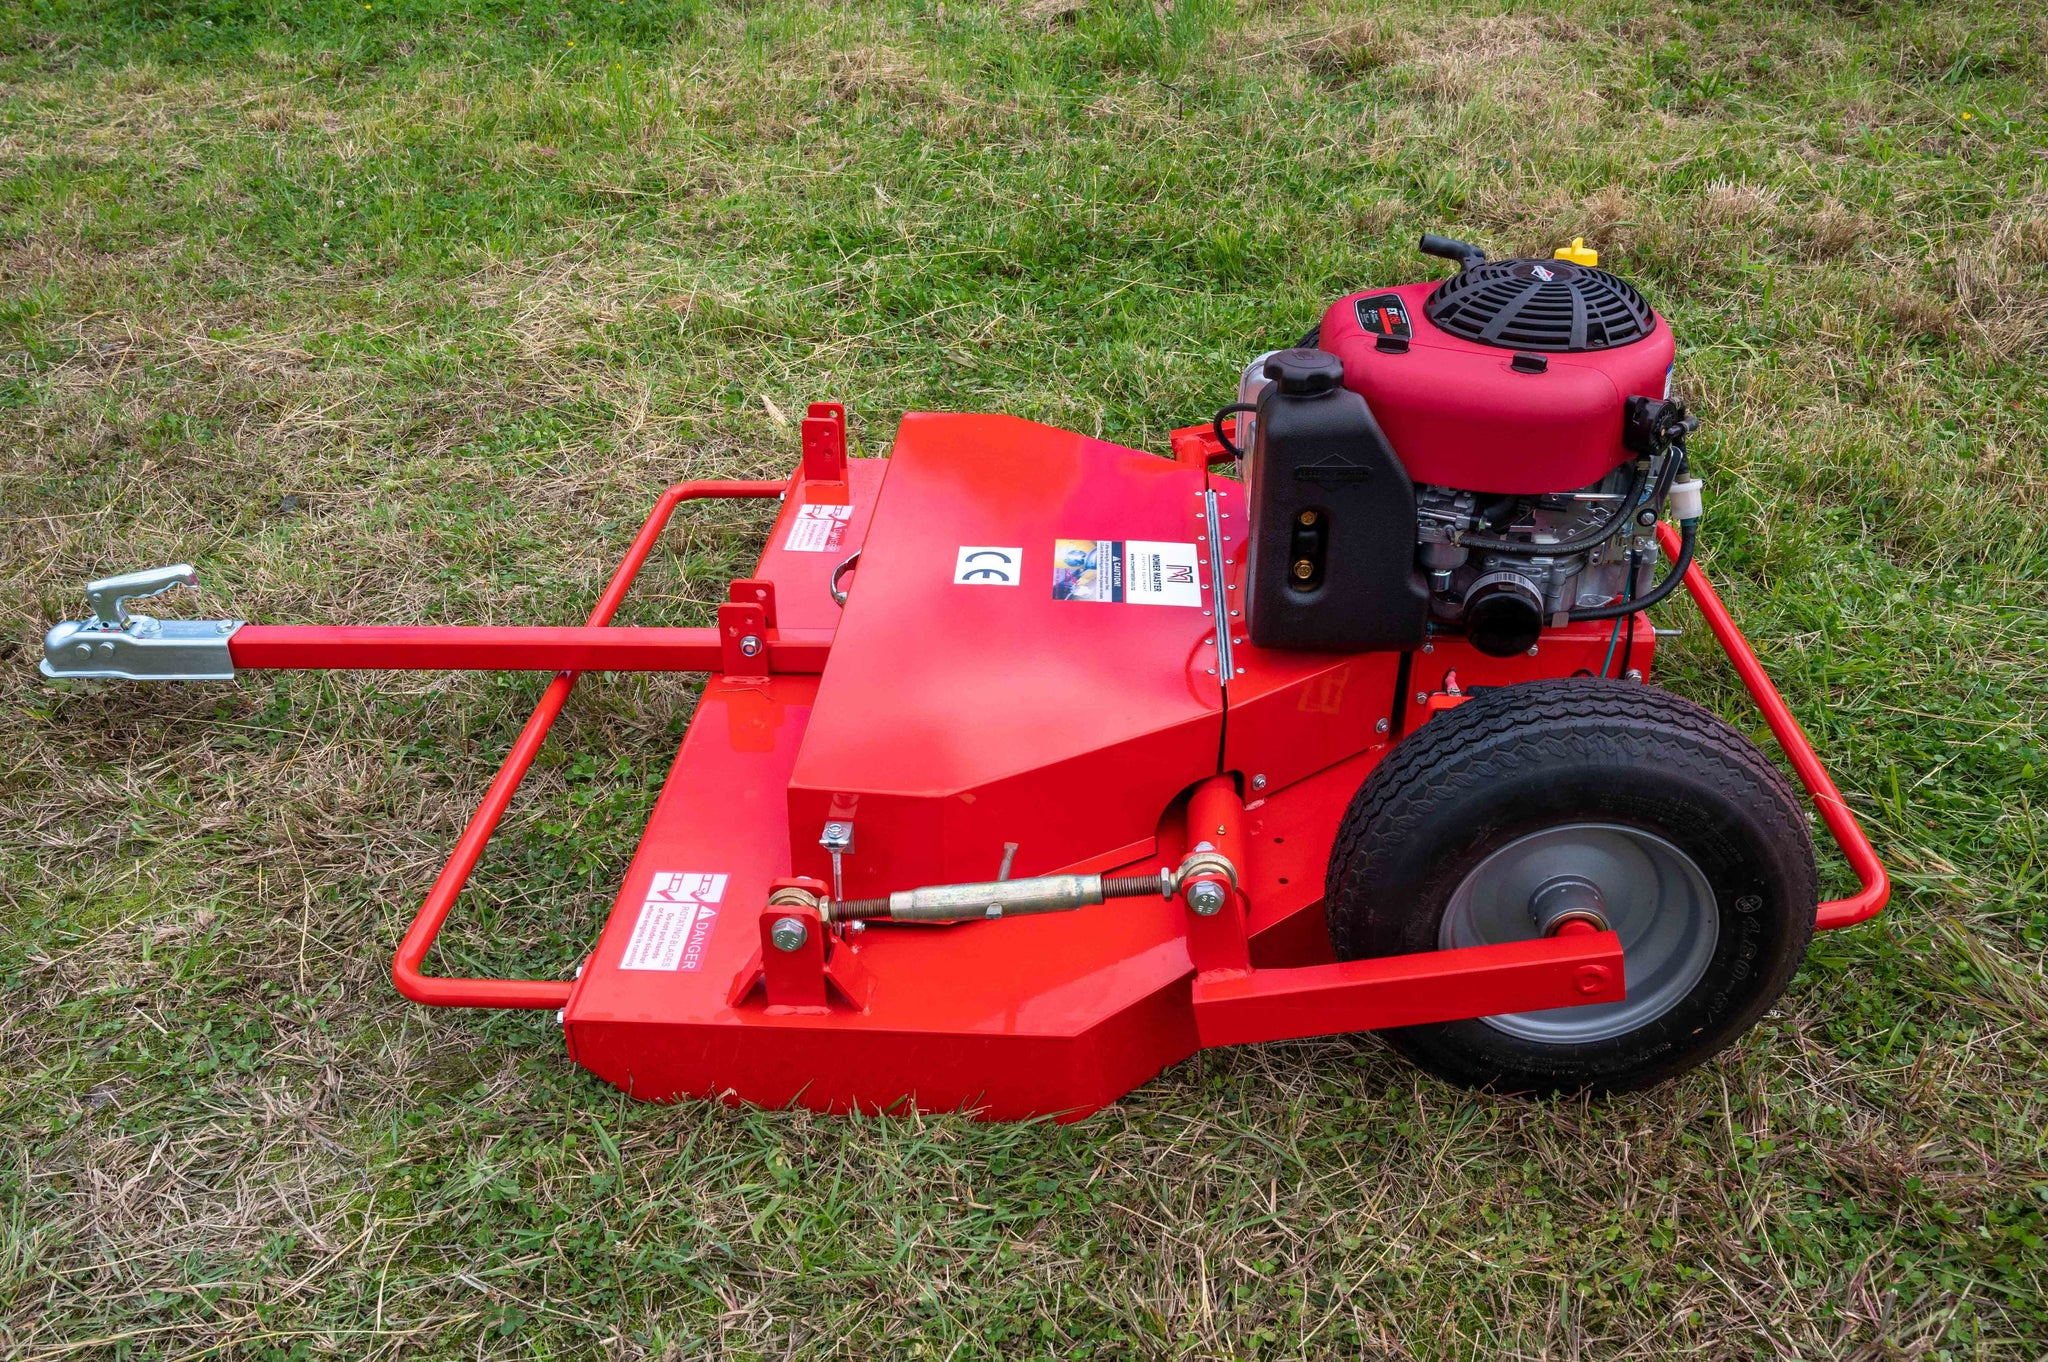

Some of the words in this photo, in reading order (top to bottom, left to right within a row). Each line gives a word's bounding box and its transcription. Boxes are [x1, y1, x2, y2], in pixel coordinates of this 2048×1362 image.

[962, 551, 1011, 582] CE
[1153, 554, 1161, 572] MOWER
[1153, 572, 1162, 592] MASTER
[646, 905, 654, 918] when
[653, 914, 663, 925] feet
[666, 912, 674, 920] Do
[639, 919, 649, 937] engine
[662, 921, 671, 931] not
[672, 906, 690, 939] ROTATING
[647, 926, 657, 942] under
[658, 931, 667, 941] put
[639, 942, 652, 964] slasher
[652, 942, 663, 959] hands
[661, 940, 678, 967] BLADES
[682, 922, 709, 969] DANGER
[625, 944, 639, 966] running
